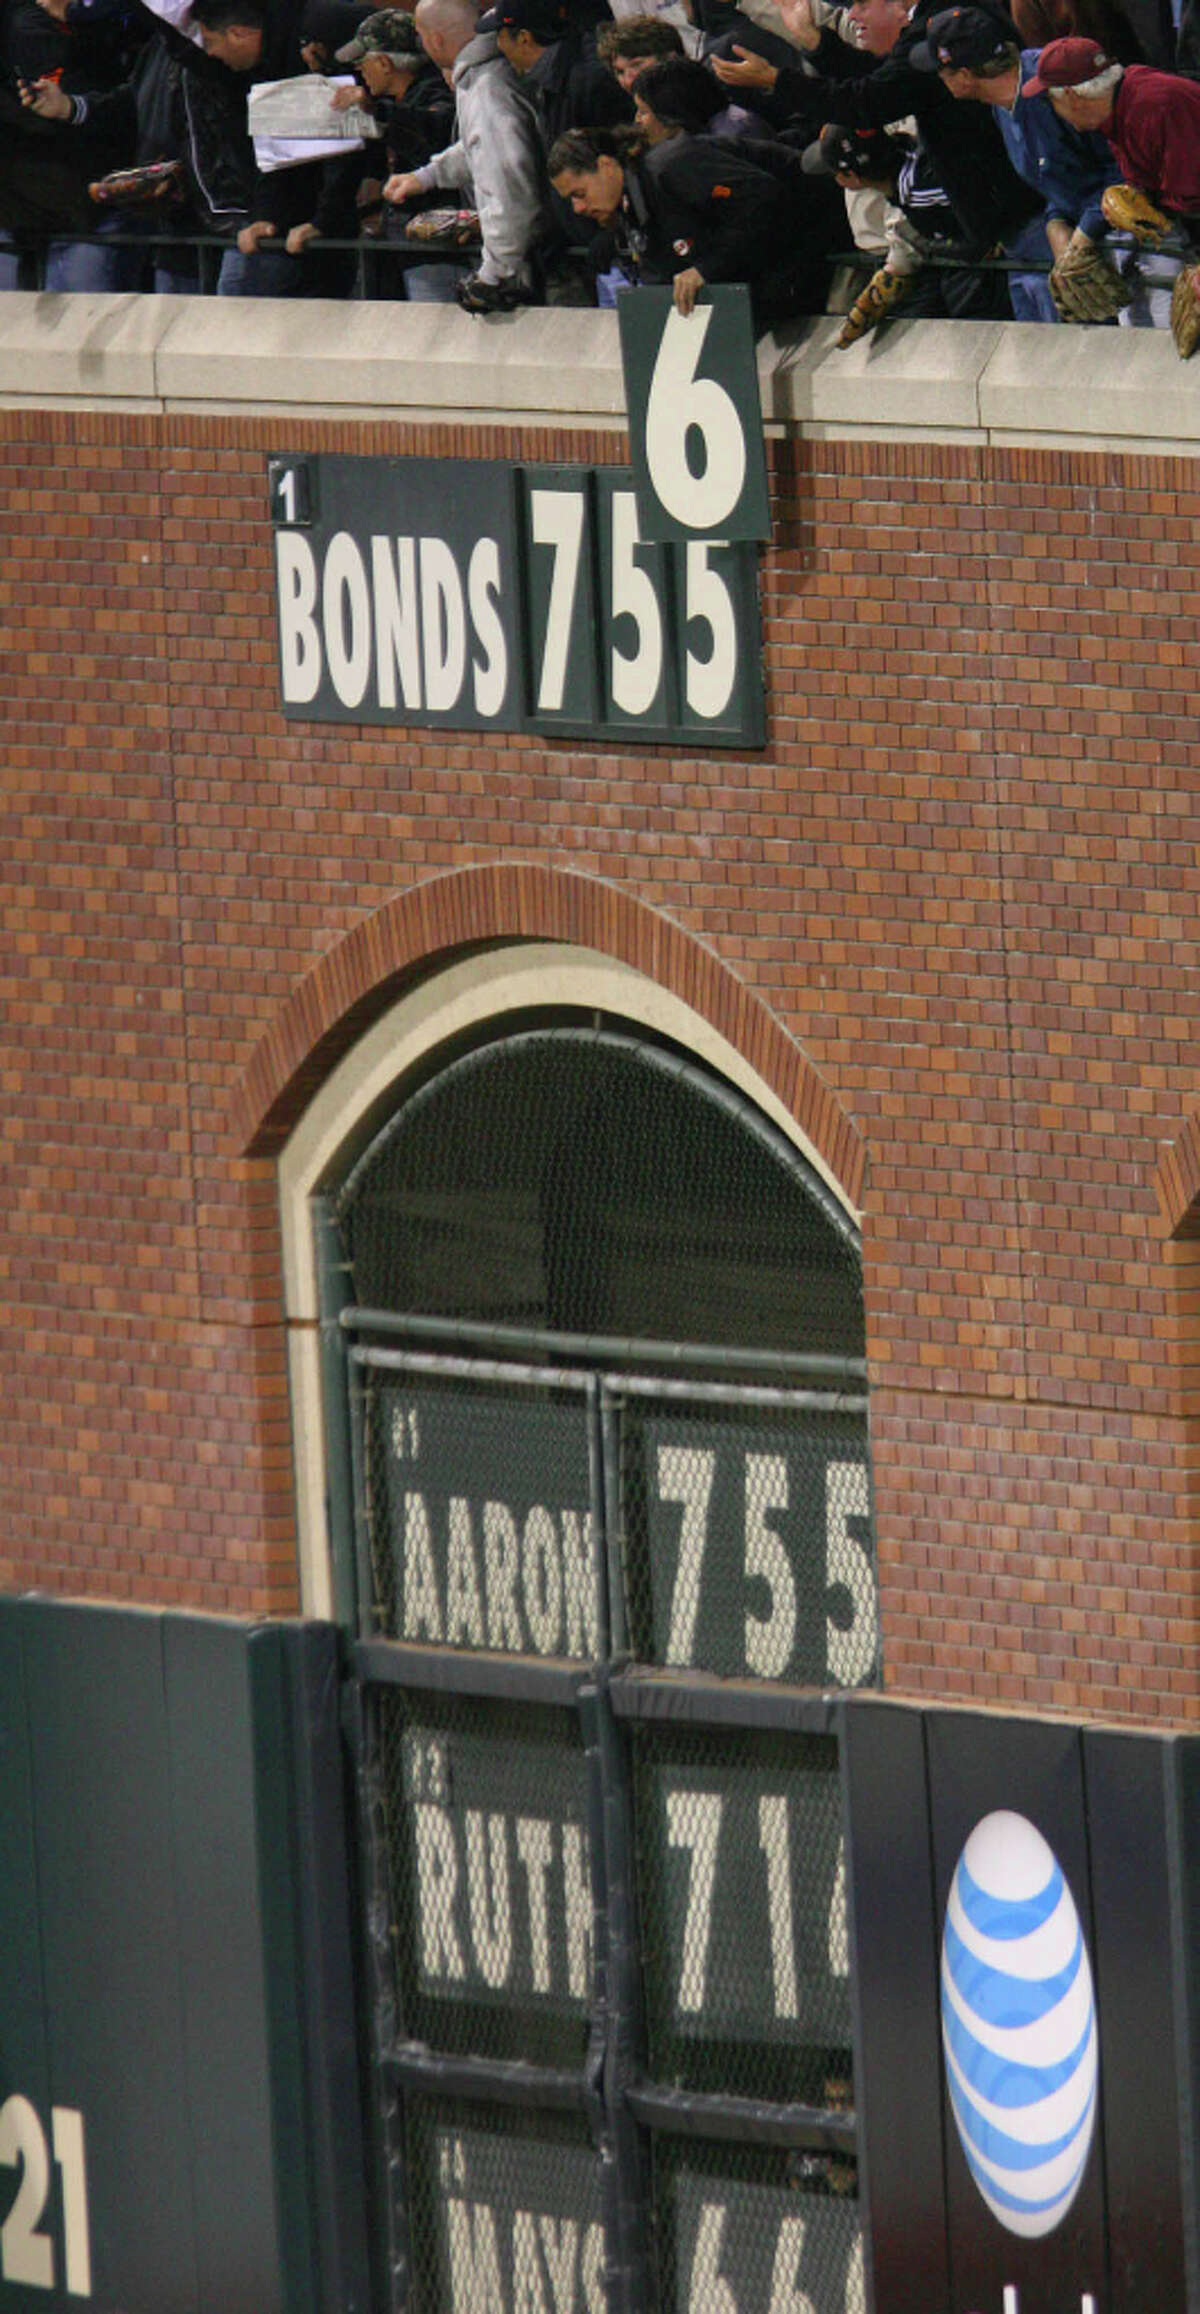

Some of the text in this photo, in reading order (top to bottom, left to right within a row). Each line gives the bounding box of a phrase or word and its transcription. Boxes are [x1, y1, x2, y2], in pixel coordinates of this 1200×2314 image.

[278, 470, 295, 522] 1
[646, 304, 746, 529] 6
[276, 490, 737, 718] BONDS 755
[656, 1445, 878, 1686] 755
[0, 2094, 91, 2297] 21
